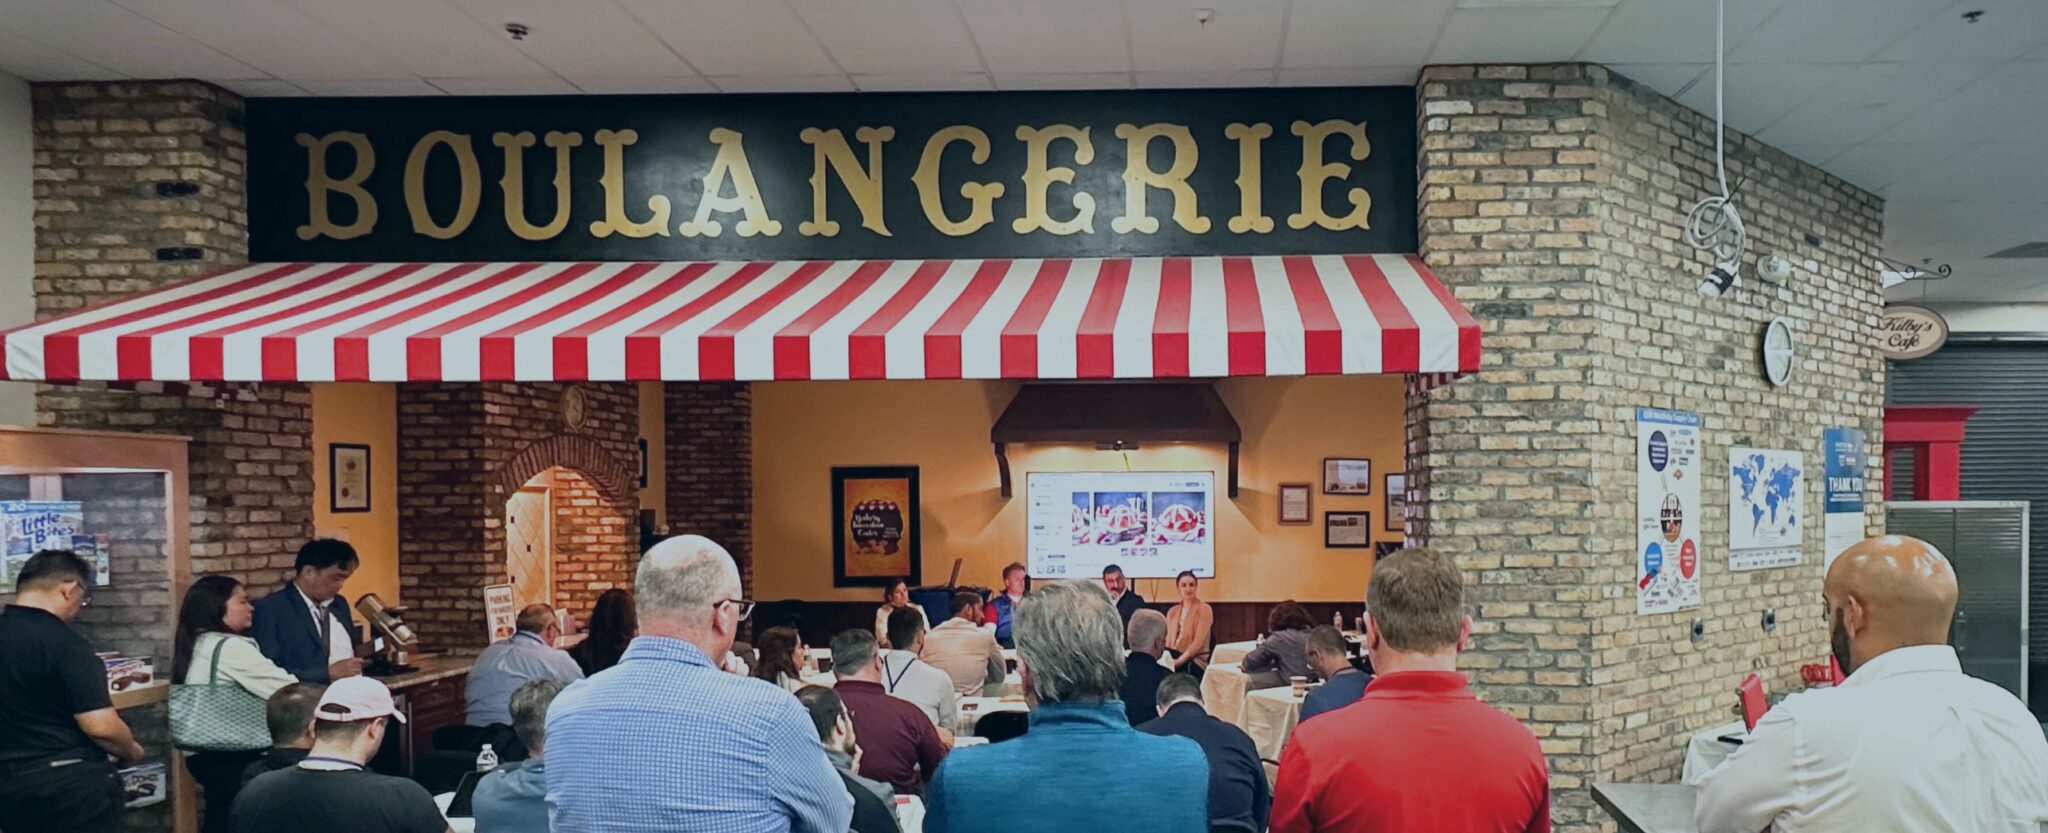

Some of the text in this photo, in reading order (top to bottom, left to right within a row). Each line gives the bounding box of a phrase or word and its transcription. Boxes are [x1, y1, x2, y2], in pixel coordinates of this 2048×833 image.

[296, 120, 1372, 241] BOULANGERIE
[1881, 317, 1933, 335] Kilby's
[1828, 477, 1863, 492] THANK YOU
[22, 512, 61, 535] Little
[35, 525, 76, 544] Bites
[490, 594, 511, 604] PARKING
